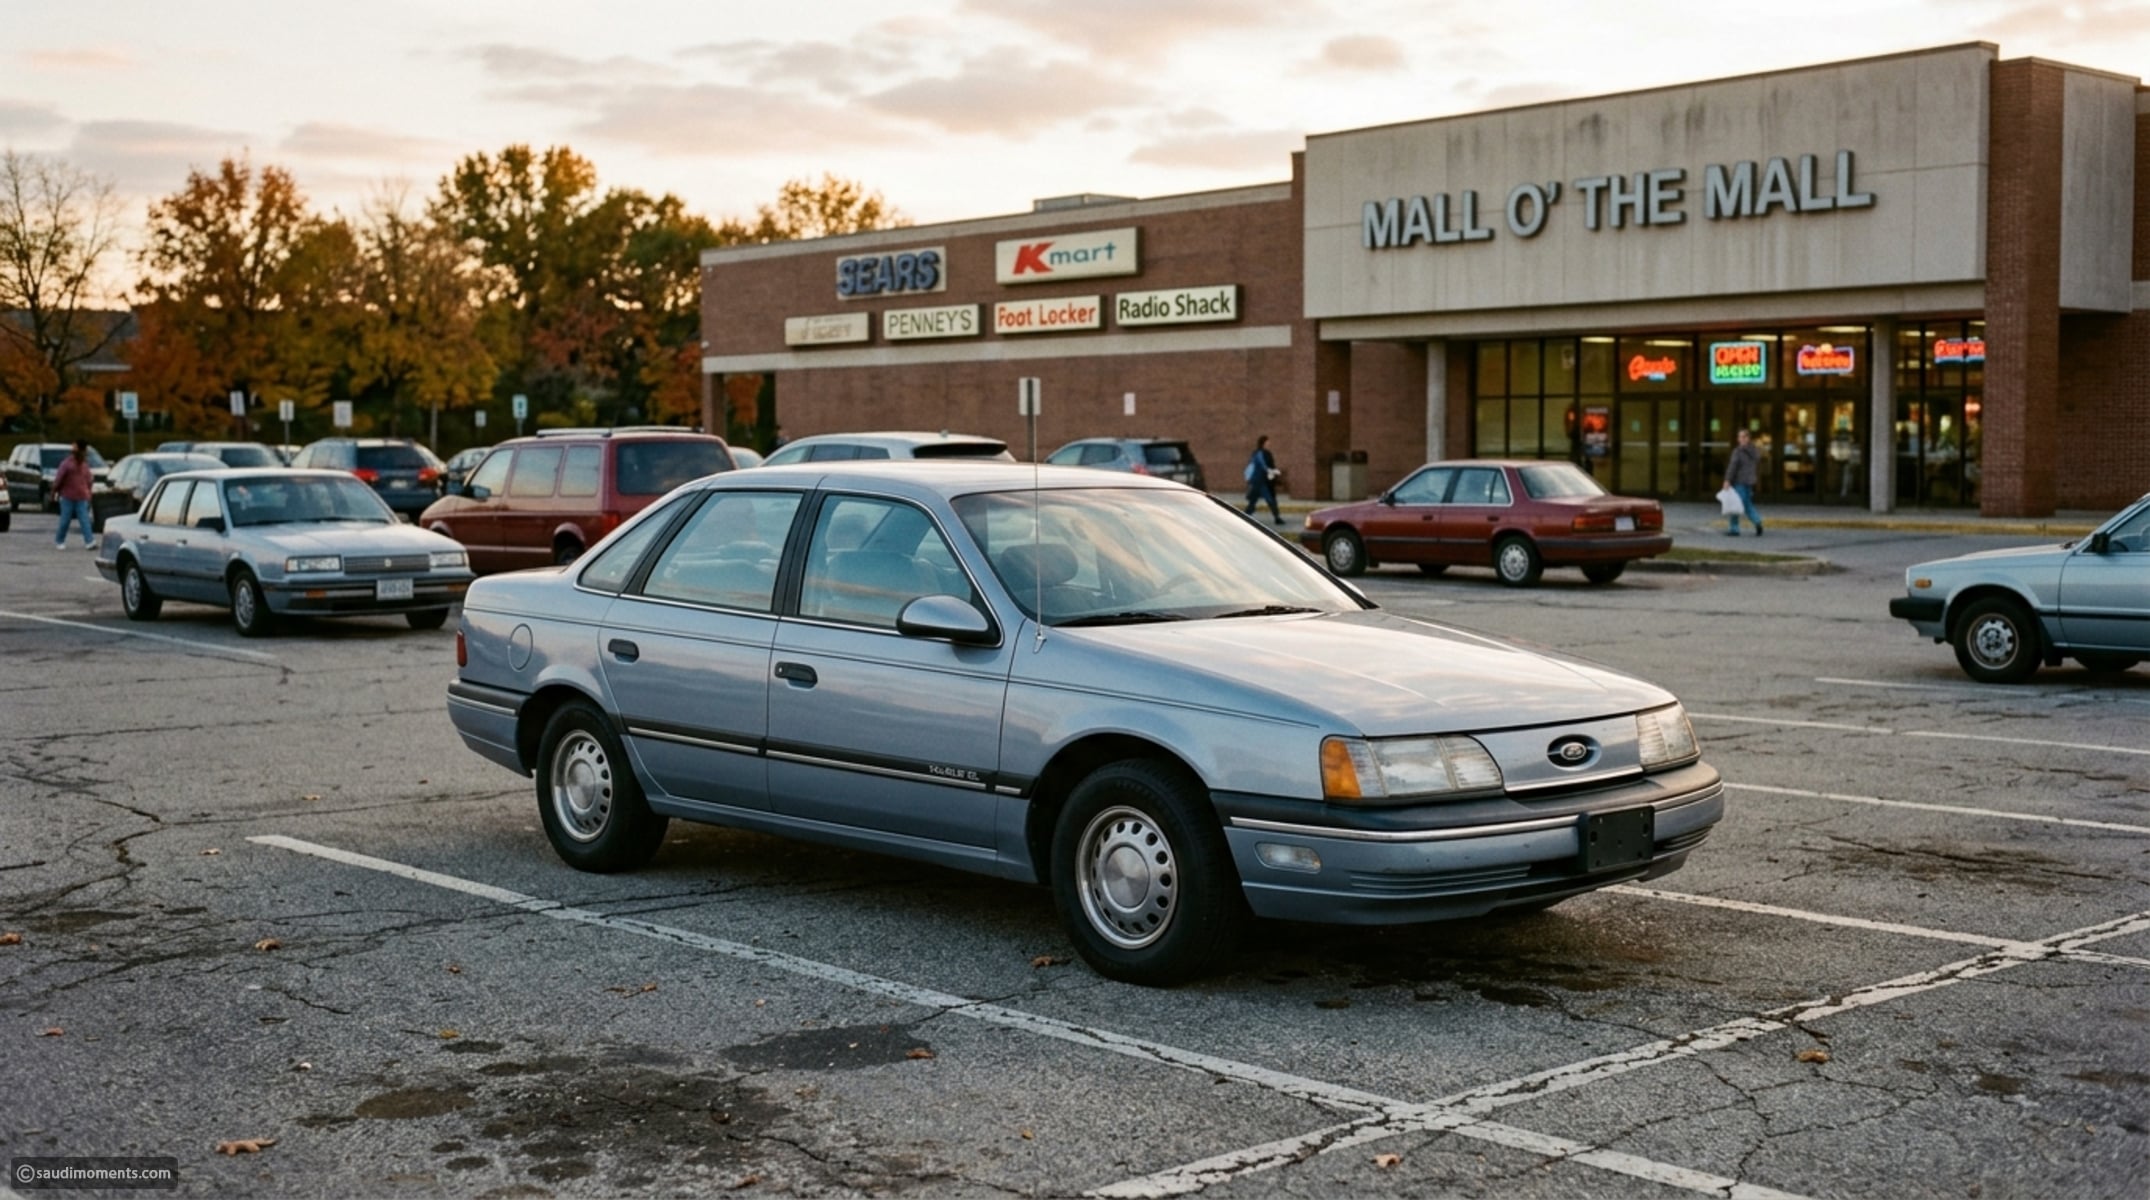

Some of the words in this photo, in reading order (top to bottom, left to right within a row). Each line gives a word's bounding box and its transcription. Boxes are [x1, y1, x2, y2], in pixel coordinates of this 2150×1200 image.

[1362, 190, 1494, 249] MALL
[1506, 182, 1560, 238] O'
[1576, 168, 1686, 231] THE
[1704, 150, 1876, 221] MALL
[837, 250, 941, 297] SEARS
[1013, 242, 1117, 275] Kmart
[999, 305, 1033, 328] Foot
[1039, 302, 1096, 326] Locker
[1119, 296, 1171, 319] Radio
[1175, 291, 1231, 317] Shack
